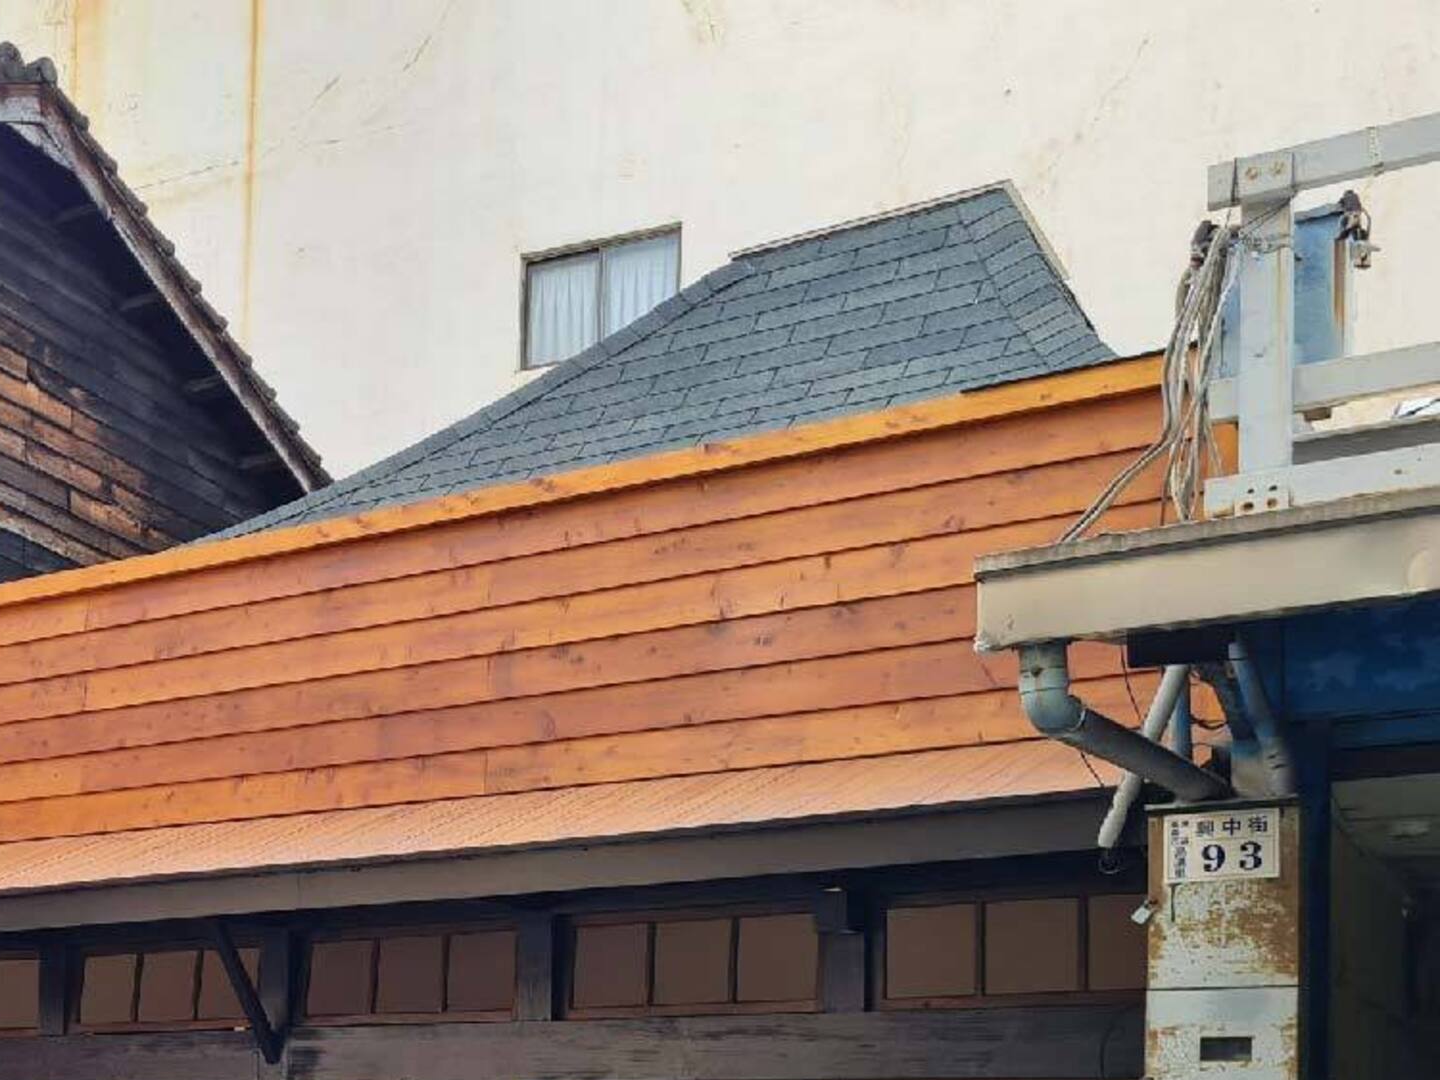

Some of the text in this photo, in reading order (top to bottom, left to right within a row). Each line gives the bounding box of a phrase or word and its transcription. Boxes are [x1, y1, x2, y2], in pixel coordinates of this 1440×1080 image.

[1195, 815, 1268, 837] 興中街
[1201, 840, 1263, 873] 93
